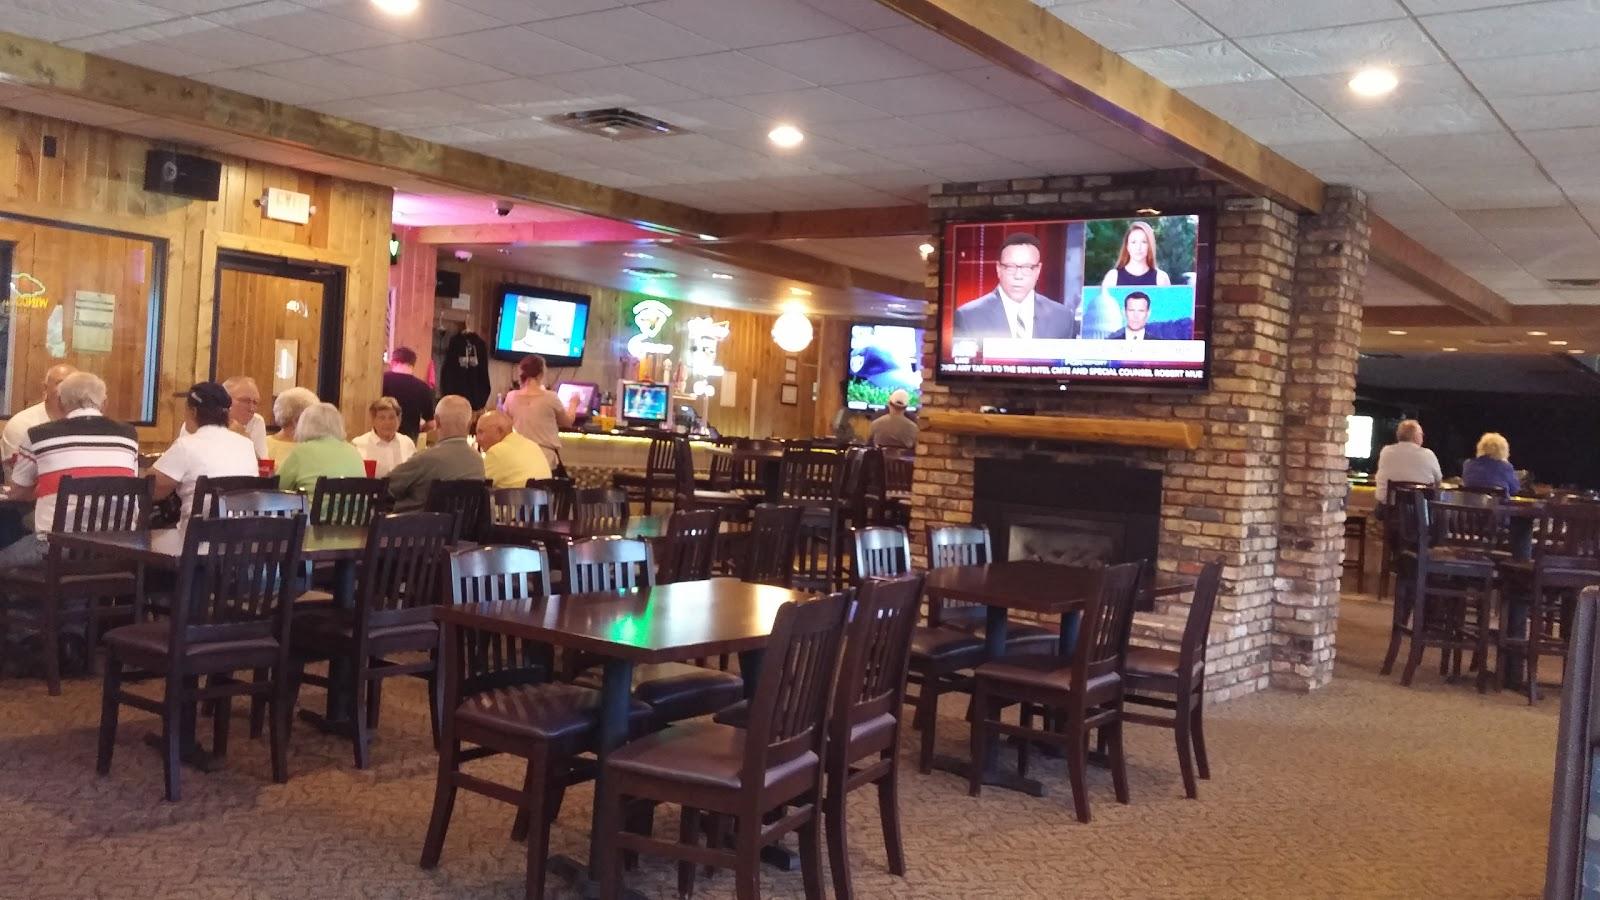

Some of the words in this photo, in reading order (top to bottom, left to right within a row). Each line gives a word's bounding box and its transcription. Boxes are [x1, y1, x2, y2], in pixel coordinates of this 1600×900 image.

[993, 364, 1003, 373] TO
[1089, 367, 1118, 376] SPECIAL
[1118, 368, 1153, 377] COUNSEL
[1154, 369, 1184, 378] ROBERT
